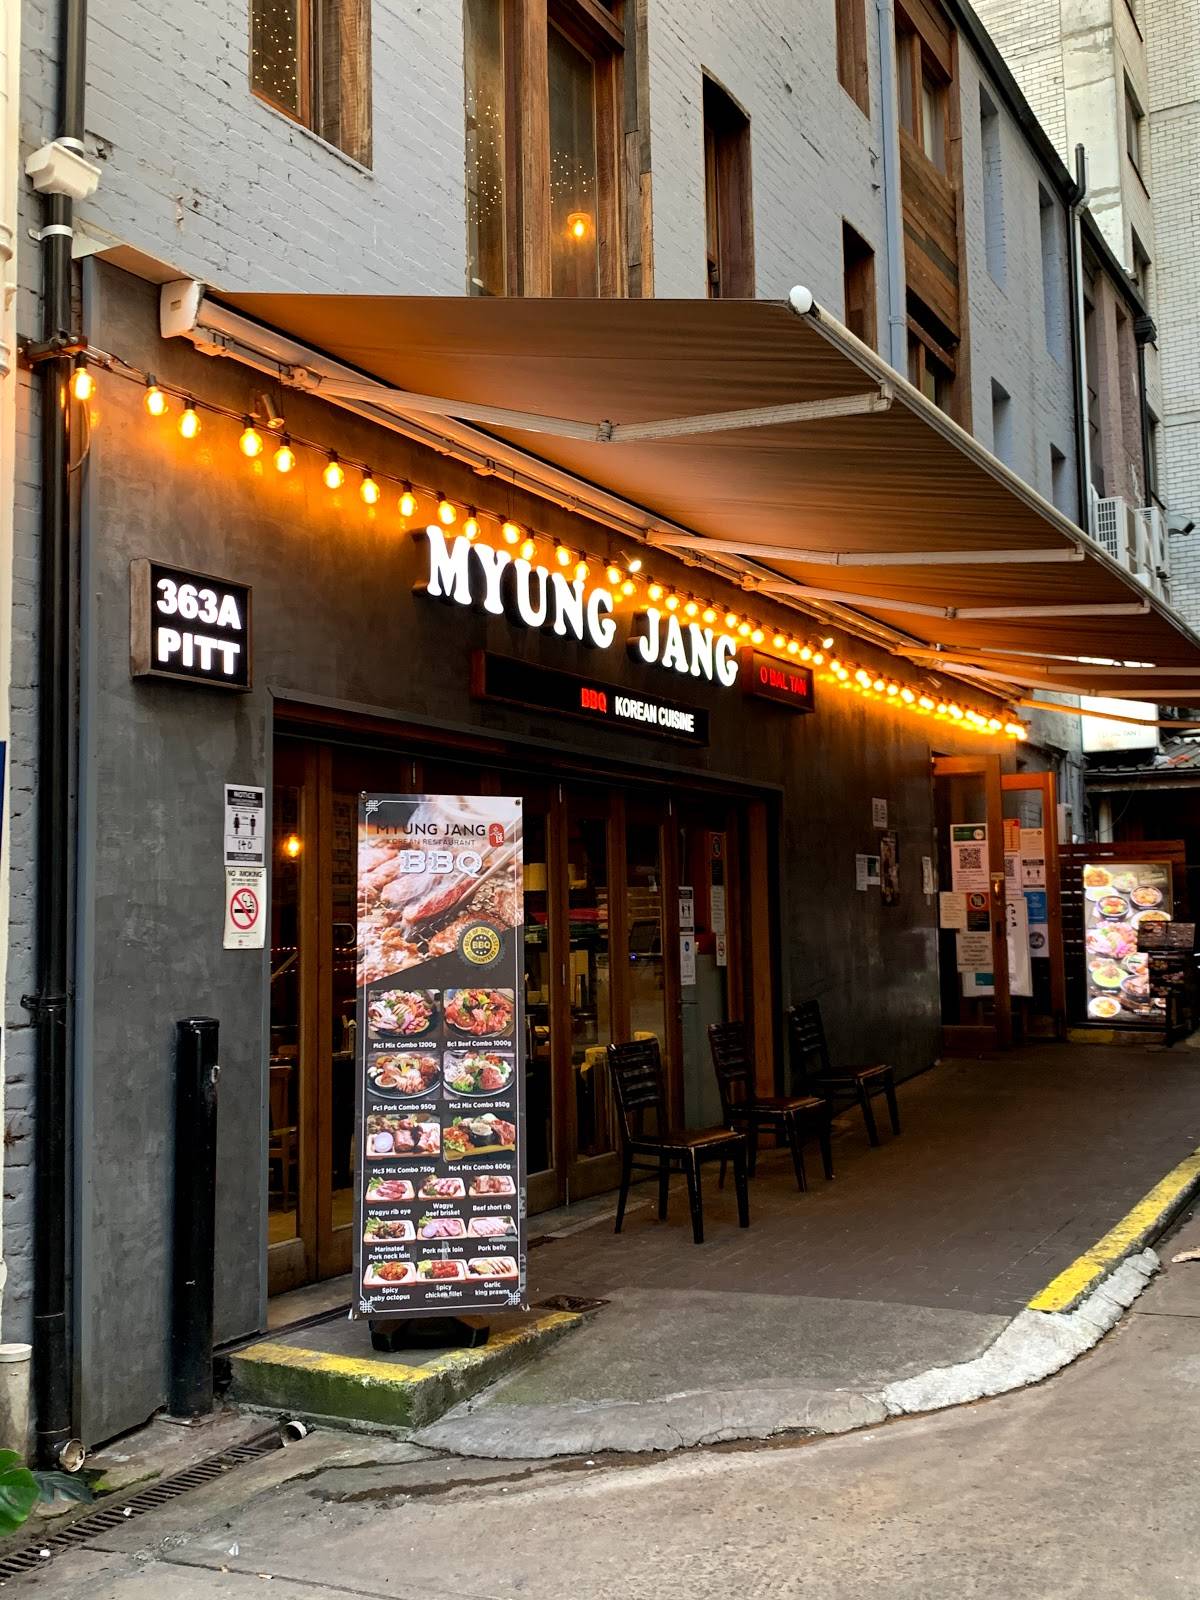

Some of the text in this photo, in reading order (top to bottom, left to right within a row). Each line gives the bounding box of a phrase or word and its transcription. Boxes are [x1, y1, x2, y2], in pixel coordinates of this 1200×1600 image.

[157, 578, 242, 630] 363A
[426, 525, 738, 687] MYUNG JANG
[157, 626, 241, 675] PITT
[760, 664, 767, 683] O
[789, 674, 807, 696] TAN
[581, 687, 695, 732] BBQ KOREAN CUISINE
[233, 791, 257, 799] NOTICE
[376, 822, 438, 835] MYUNG
[444, 824, 486, 836] JANG
[386, 837, 475, 846] KOREAN RESTAURANT
[399, 849, 483, 878] BBQ
[239, 870, 263, 878] MOKING
[472, 941, 491, 949] BBQ
[418, 1041, 437, 1049] 1200g
[493, 1040, 512, 1048] 1000g
[420, 1103, 436, 1111] 950g
[420, 1166, 435, 1174] 750g
[400, 1208, 411, 1216] eye
[382, 1287, 399, 1295] Spicy
[435, 1284, 452, 1292] Spicy
[475, 1288, 510, 1297] king prawns
[369, 1293, 410, 1303] baby octopus
